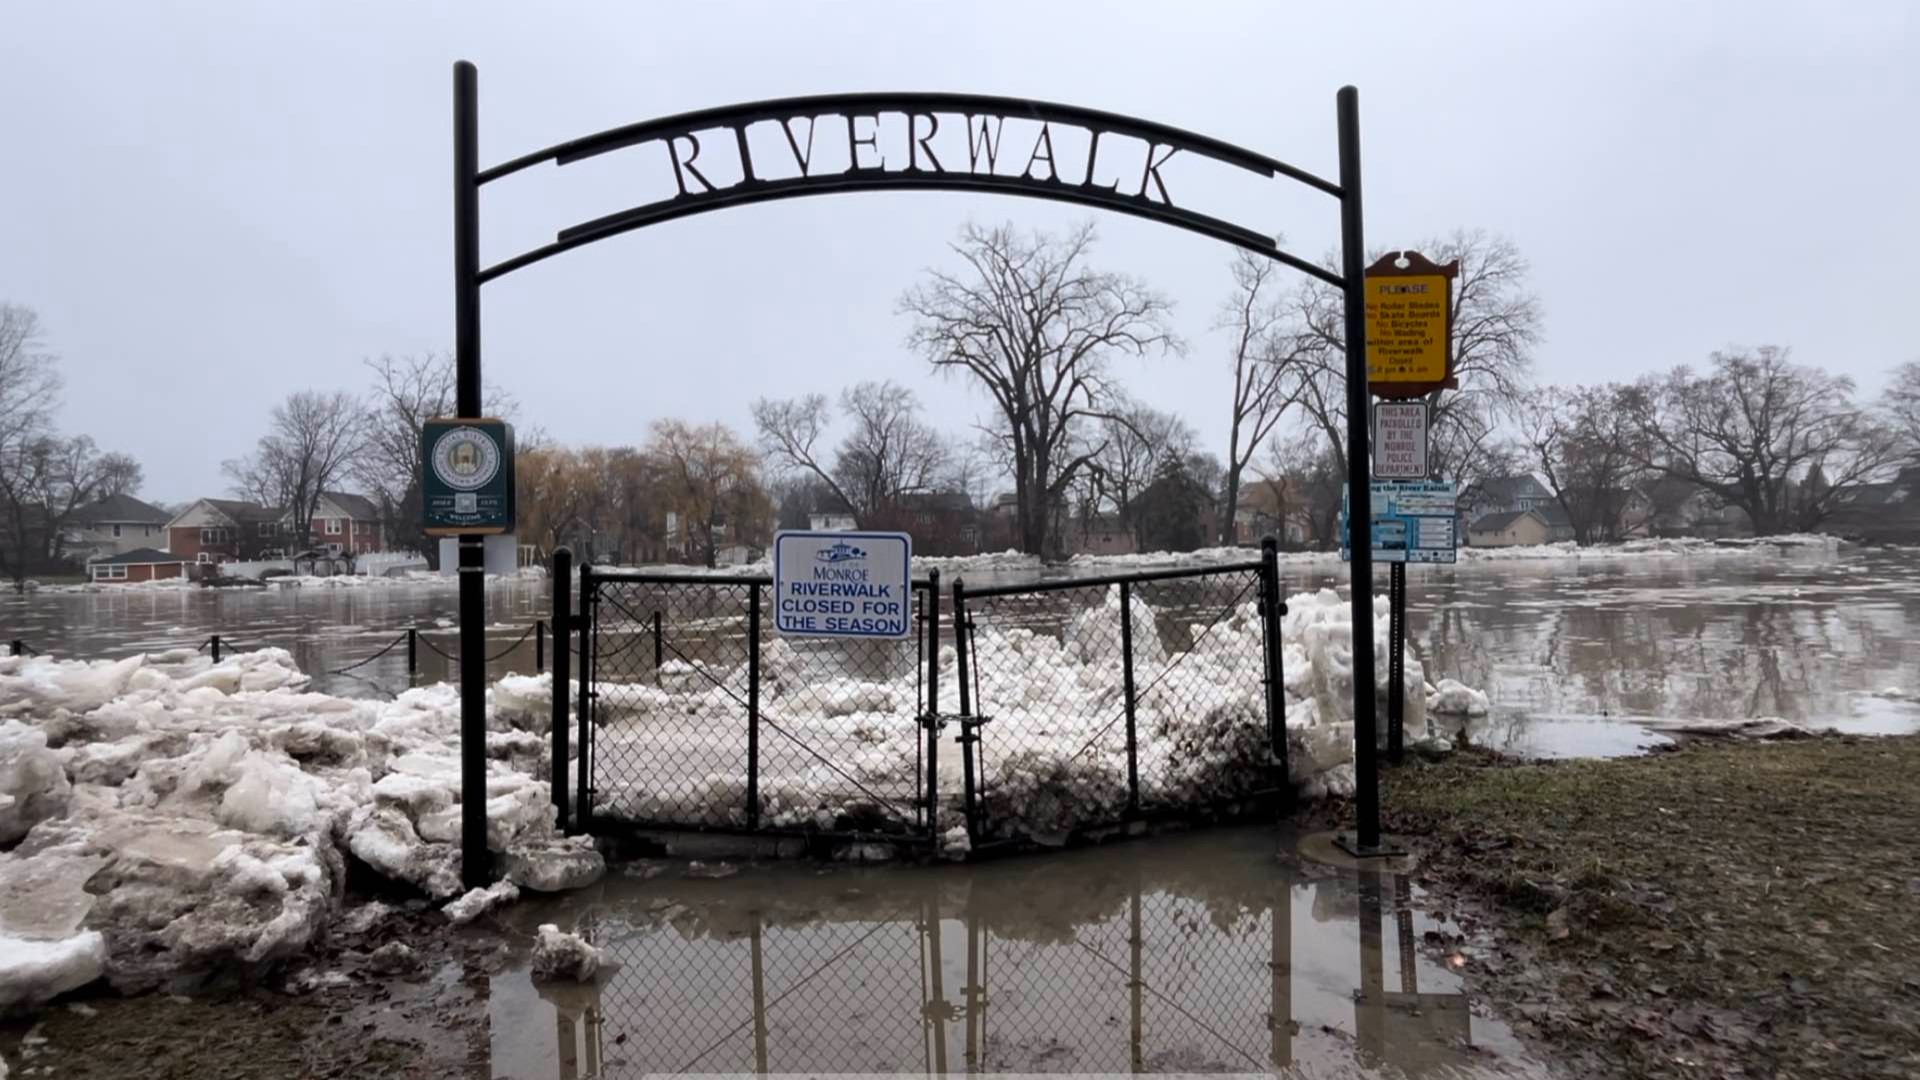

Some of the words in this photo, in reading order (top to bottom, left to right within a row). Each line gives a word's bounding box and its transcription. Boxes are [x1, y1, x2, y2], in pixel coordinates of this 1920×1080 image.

[664, 111, 1180, 206] RIVERWALK
[1379, 284, 1429, 295] PLEASE
[1391, 320, 1428, 329] Bicycles
[1423, 337, 1433, 345] of
[1378, 347, 1424, 355] Riverwalk
[1381, 407, 1397, 417] THIS
[1399, 407, 1421, 417] AREA
[1380, 418, 1422, 429] PATROLLED
[1387, 430, 1396, 440] BY
[1400, 430, 1413, 440] THE
[1386, 453, 1413, 463] POLICE
[1376, 464, 1424, 474] DEPARTMENT
[1399, 485, 1421, 493] River
[813, 566, 869, 583] MONROE
[791, 582, 890, 598] RIVERWALK
[782, 599, 855, 614] CLOSED
[863, 602, 900, 616] FOR
[783, 615, 816, 629] THE
[825, 617, 900, 632] SEASON
